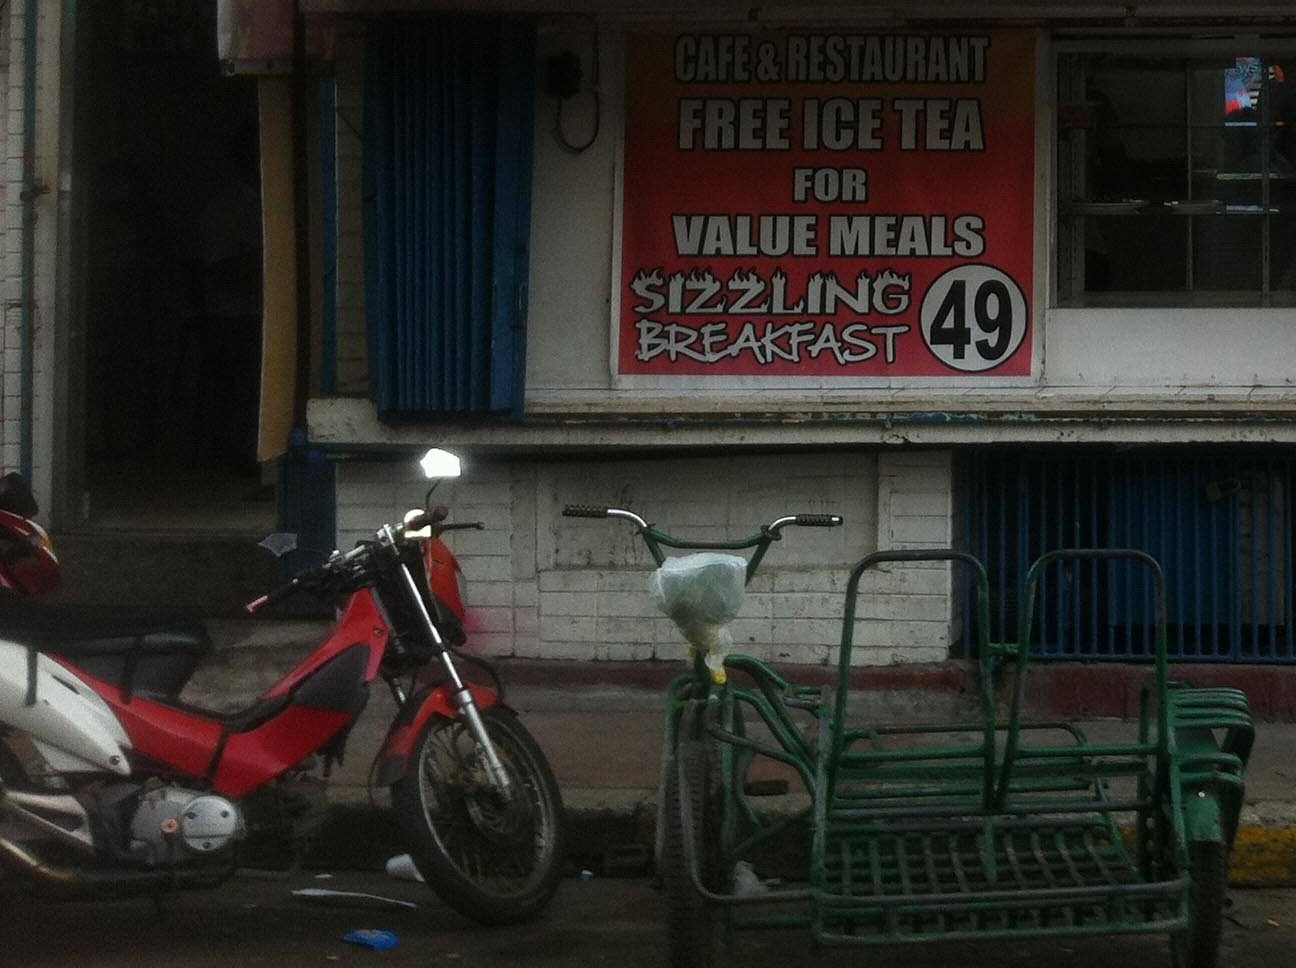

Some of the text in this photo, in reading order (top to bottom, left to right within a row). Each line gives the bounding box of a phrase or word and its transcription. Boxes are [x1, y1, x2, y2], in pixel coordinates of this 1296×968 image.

[675, 35, 990, 83] CAFE & RESTAURANT
[677, 98, 985, 151] FREE ICE TEA
[793, 168, 868, 202] FOR
[672, 215, 985, 257] VALUE MEALS
[631, 267, 912, 316] SIZZLING
[635, 319, 911, 365] BREAKFAST
[929, 279, 1013, 361] 49
